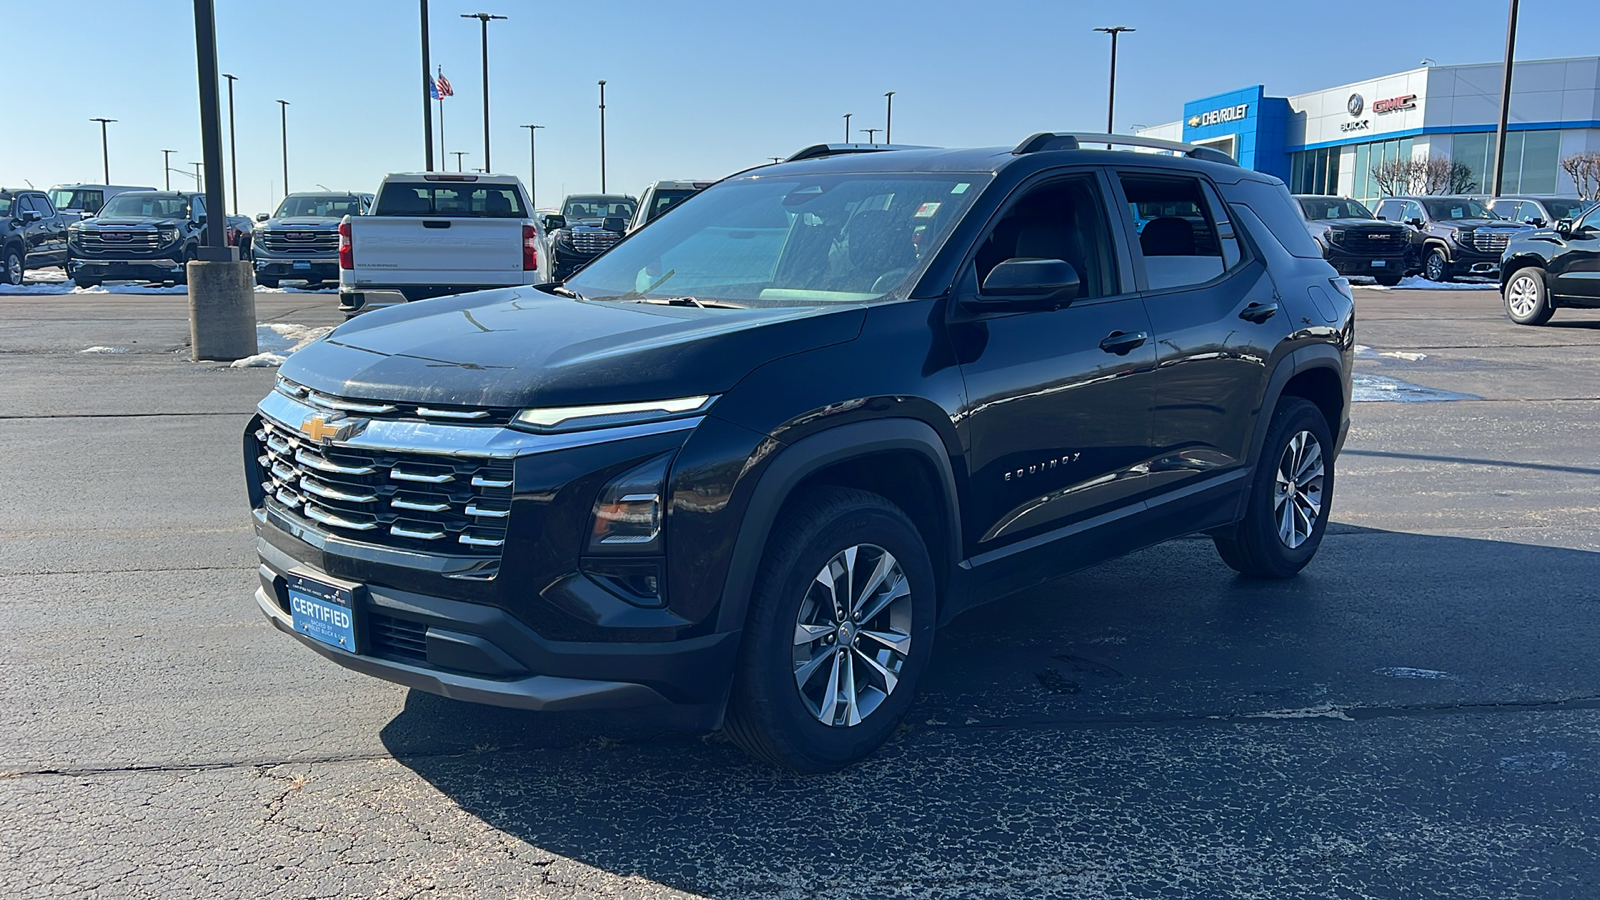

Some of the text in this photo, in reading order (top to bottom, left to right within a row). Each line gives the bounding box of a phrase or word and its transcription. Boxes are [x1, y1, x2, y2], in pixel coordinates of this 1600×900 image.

[1373, 94, 1416, 113] GMC
[1202, 103, 1248, 126] CHEVROLET
[1340, 120, 1369, 131] BUICK
[1004, 452, 1081, 481] EQUINOX
[292, 597, 350, 629] CERTIFIED
[310, 619, 327, 629] BACKED
